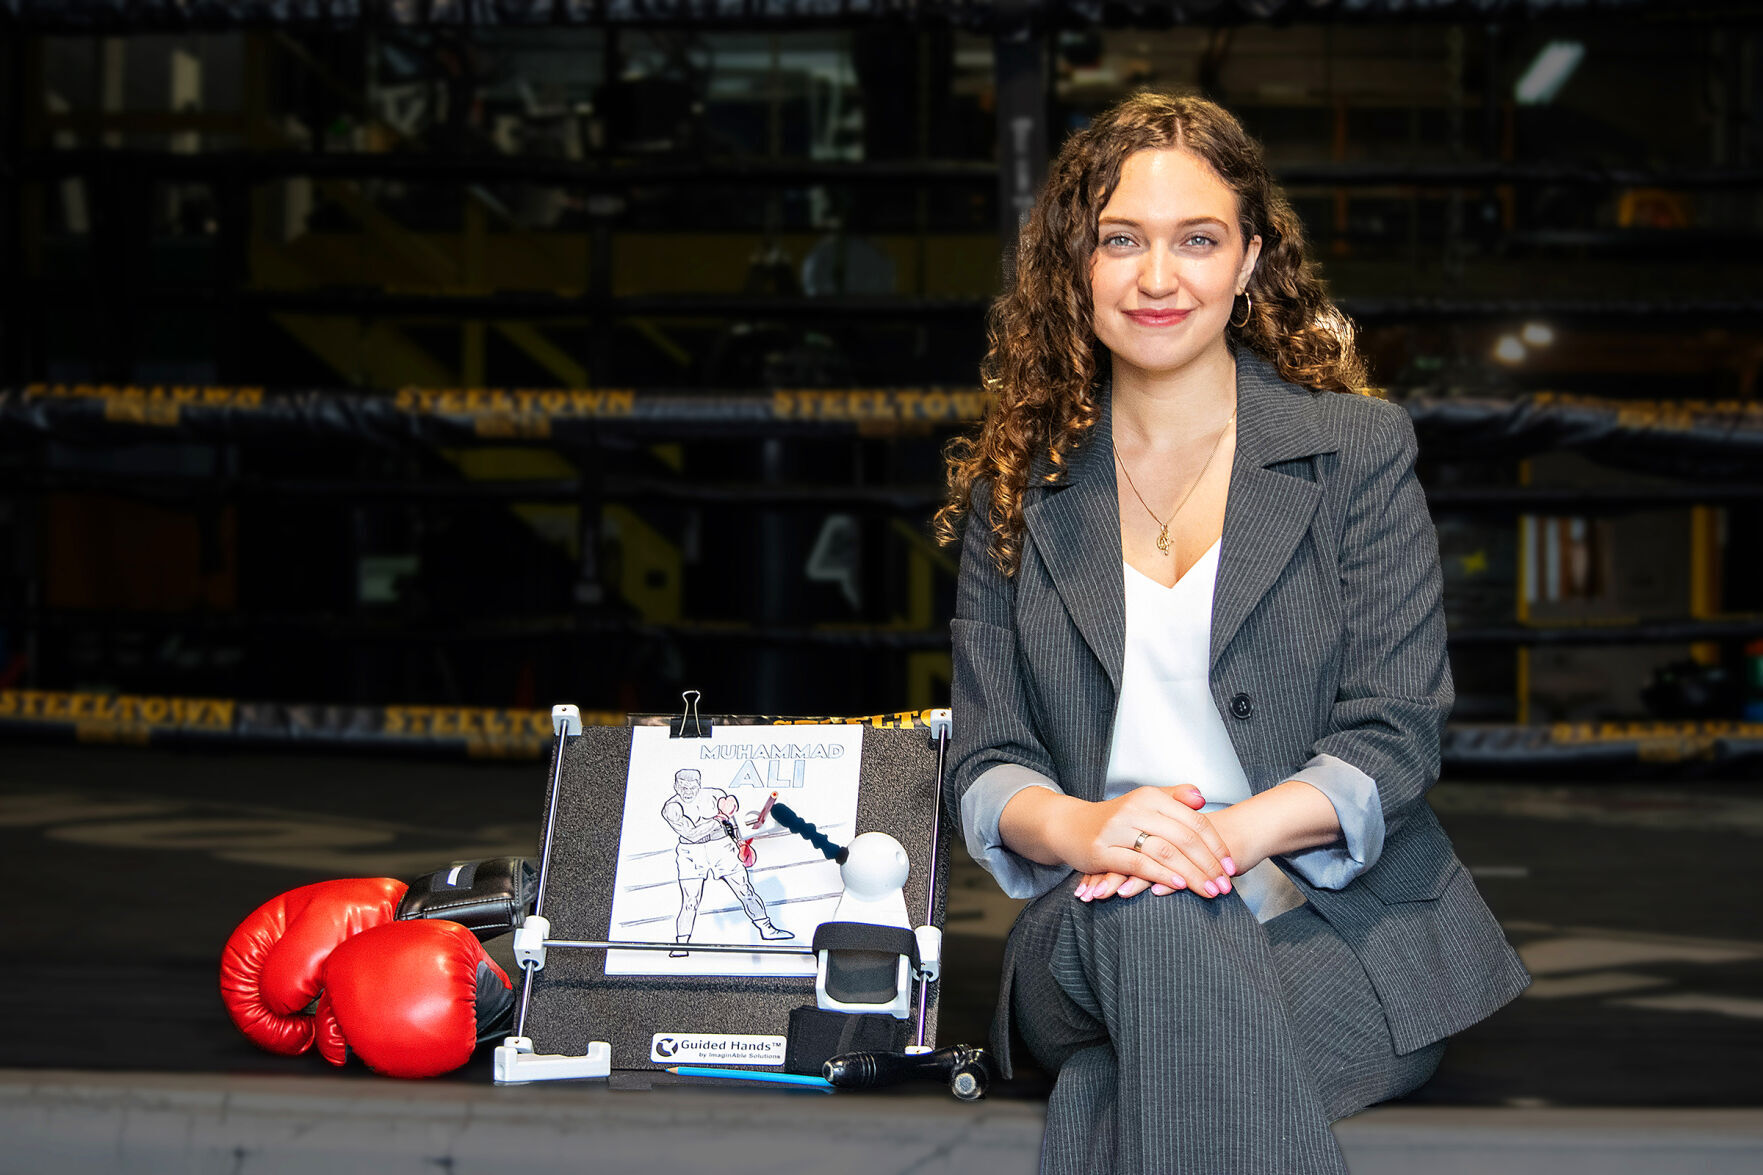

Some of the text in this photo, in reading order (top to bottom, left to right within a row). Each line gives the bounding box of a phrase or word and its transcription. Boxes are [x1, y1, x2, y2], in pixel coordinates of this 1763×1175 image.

[700, 743, 845, 760] MUHAMMAD
[728, 759, 806, 788] ALI
[681, 1039, 727, 1051] Guided
